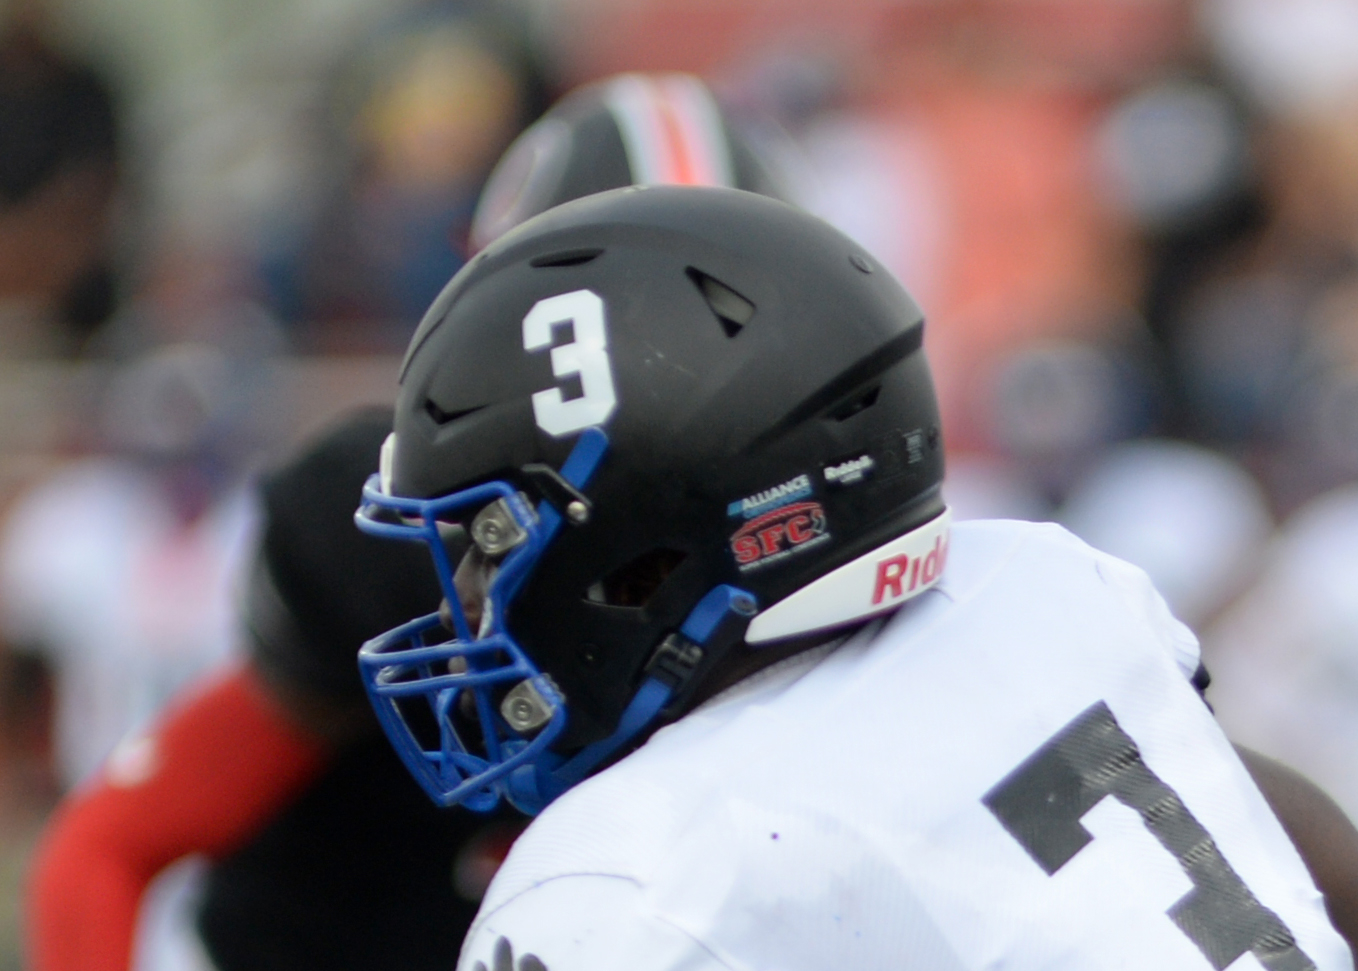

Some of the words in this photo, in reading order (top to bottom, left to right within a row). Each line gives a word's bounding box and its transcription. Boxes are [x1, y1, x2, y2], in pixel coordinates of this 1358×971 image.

[521, 288, 617, 437] 3
[742, 474, 810, 511] ALLIANCE
[731, 515, 813, 563] SFC
